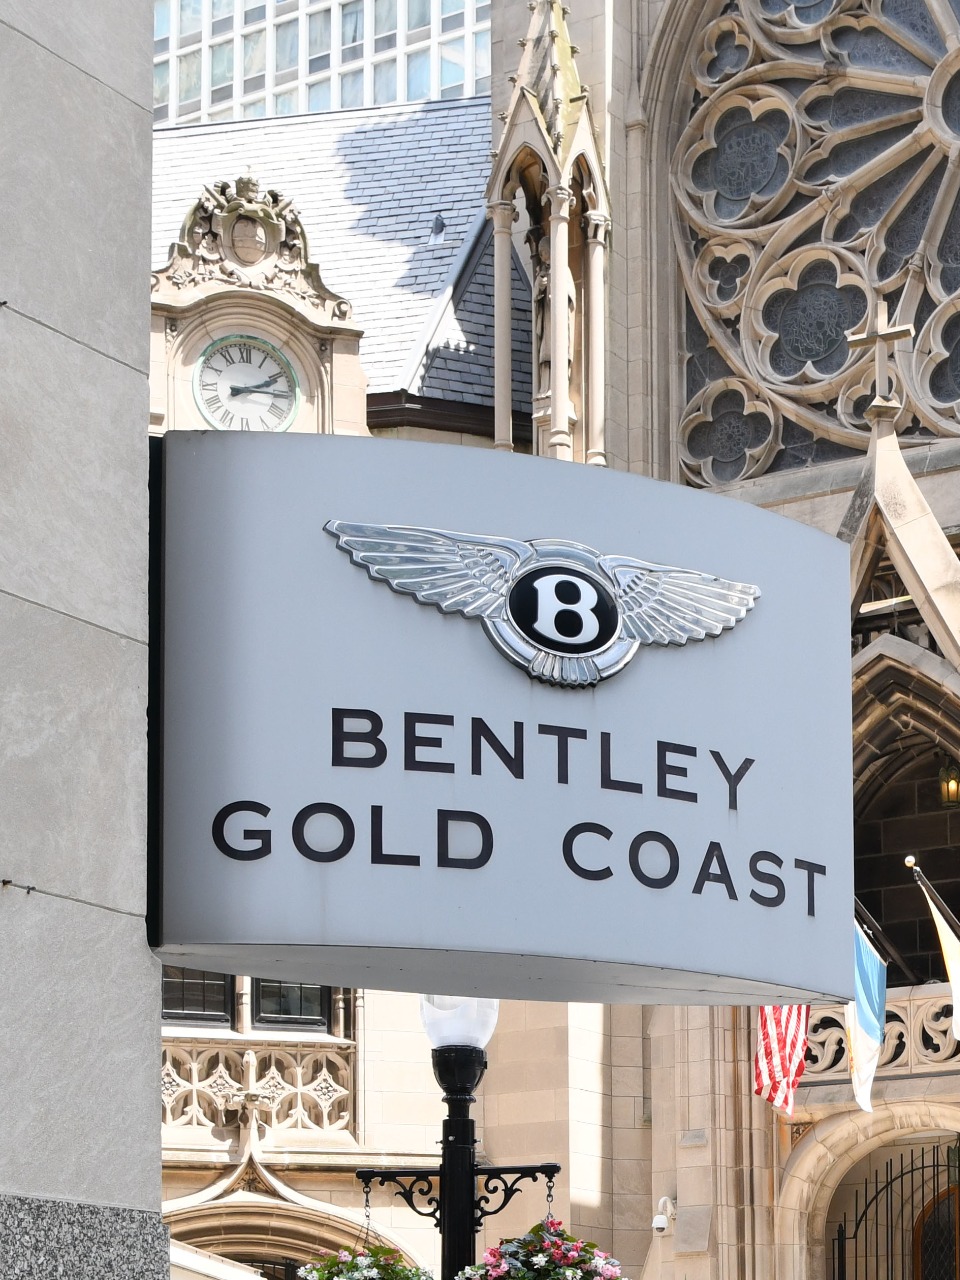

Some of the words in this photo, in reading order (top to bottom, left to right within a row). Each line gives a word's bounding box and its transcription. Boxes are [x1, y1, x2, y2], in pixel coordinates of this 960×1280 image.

[532, 573, 601, 645] B
[331, 706, 755, 810] BENTLEY
[211, 800, 494, 871] GOLD
[562, 821, 827, 917] COAST
